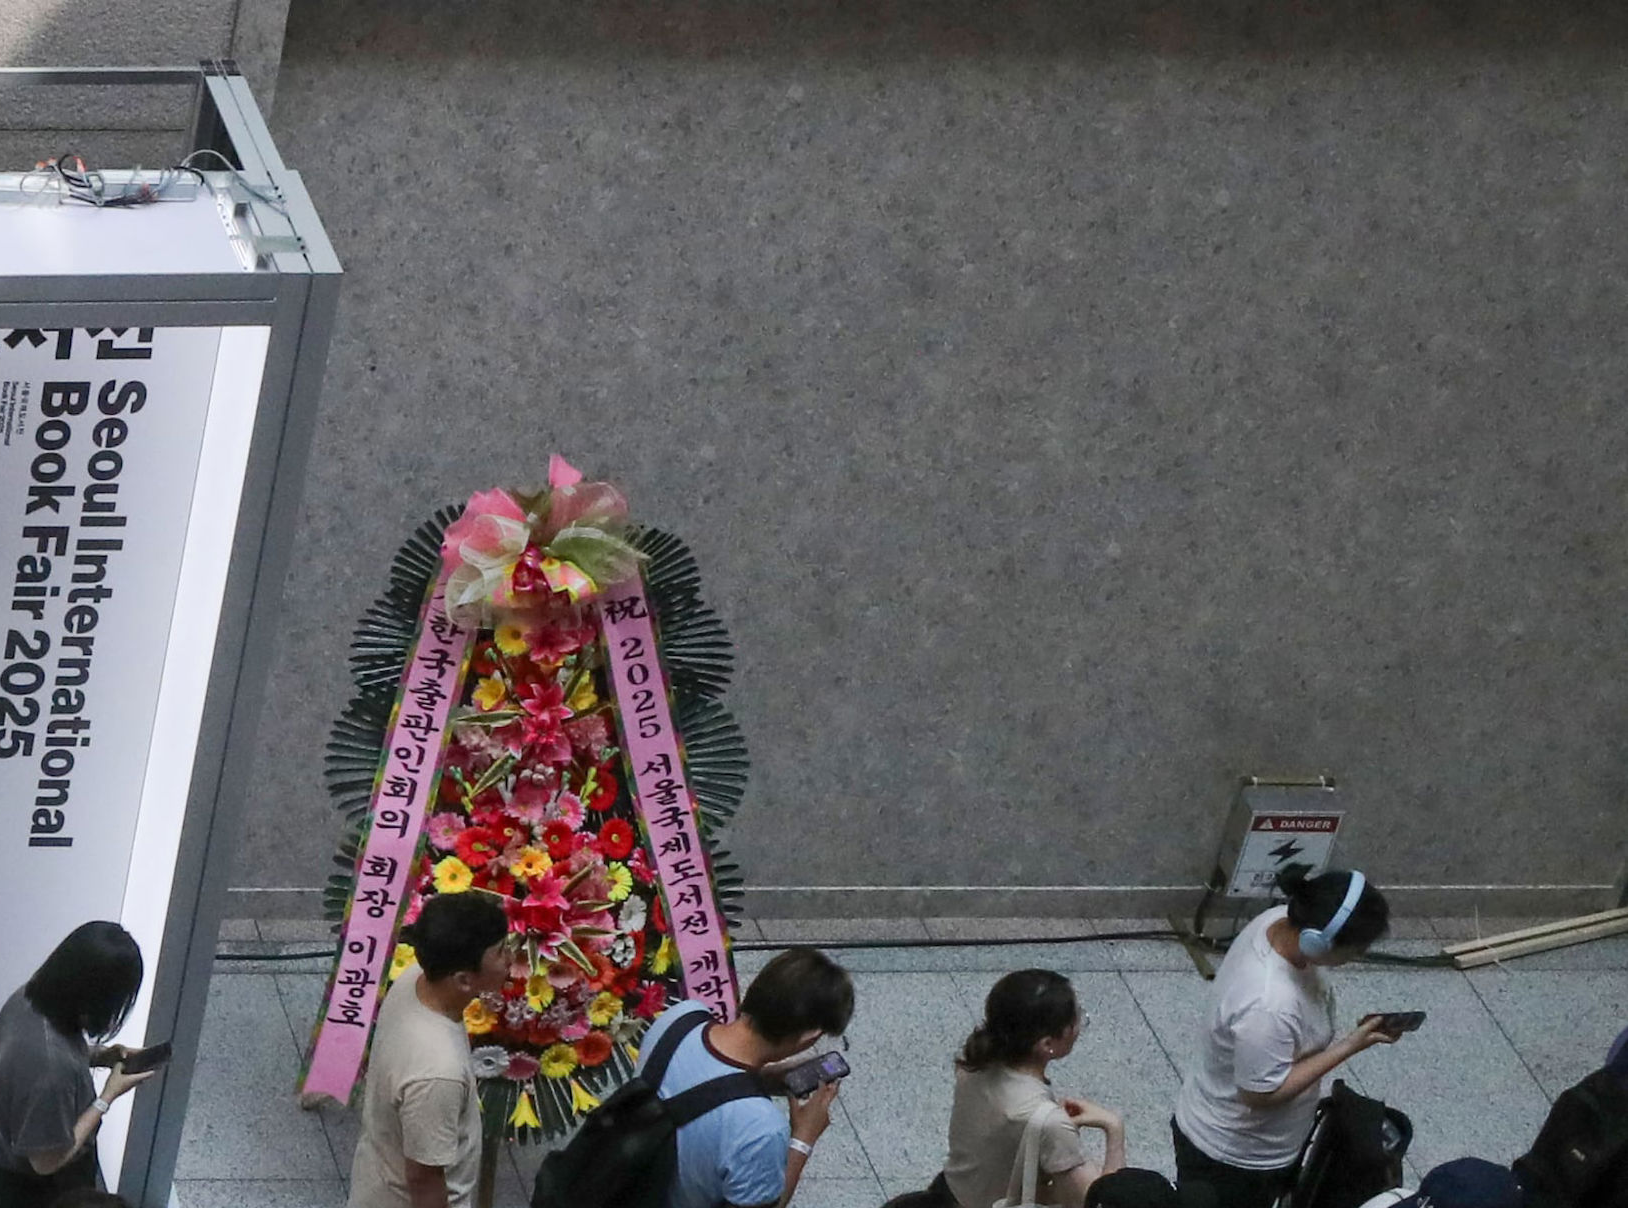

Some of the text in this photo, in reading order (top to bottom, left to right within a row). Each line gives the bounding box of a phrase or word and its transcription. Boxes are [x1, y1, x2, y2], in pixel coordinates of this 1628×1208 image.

[25, 381, 91, 516] Book
[11, 525, 70, 621] Fair
[28, 379, 147, 848] Seoul International
[619, 636, 662, 739] 2025
[638, 753, 710, 935] 서울국제도서전
[1279, 820, 1332, 829] DANGER
[356, 855, 398, 919] 회장
[327, 935, 376, 1028] 이광호
